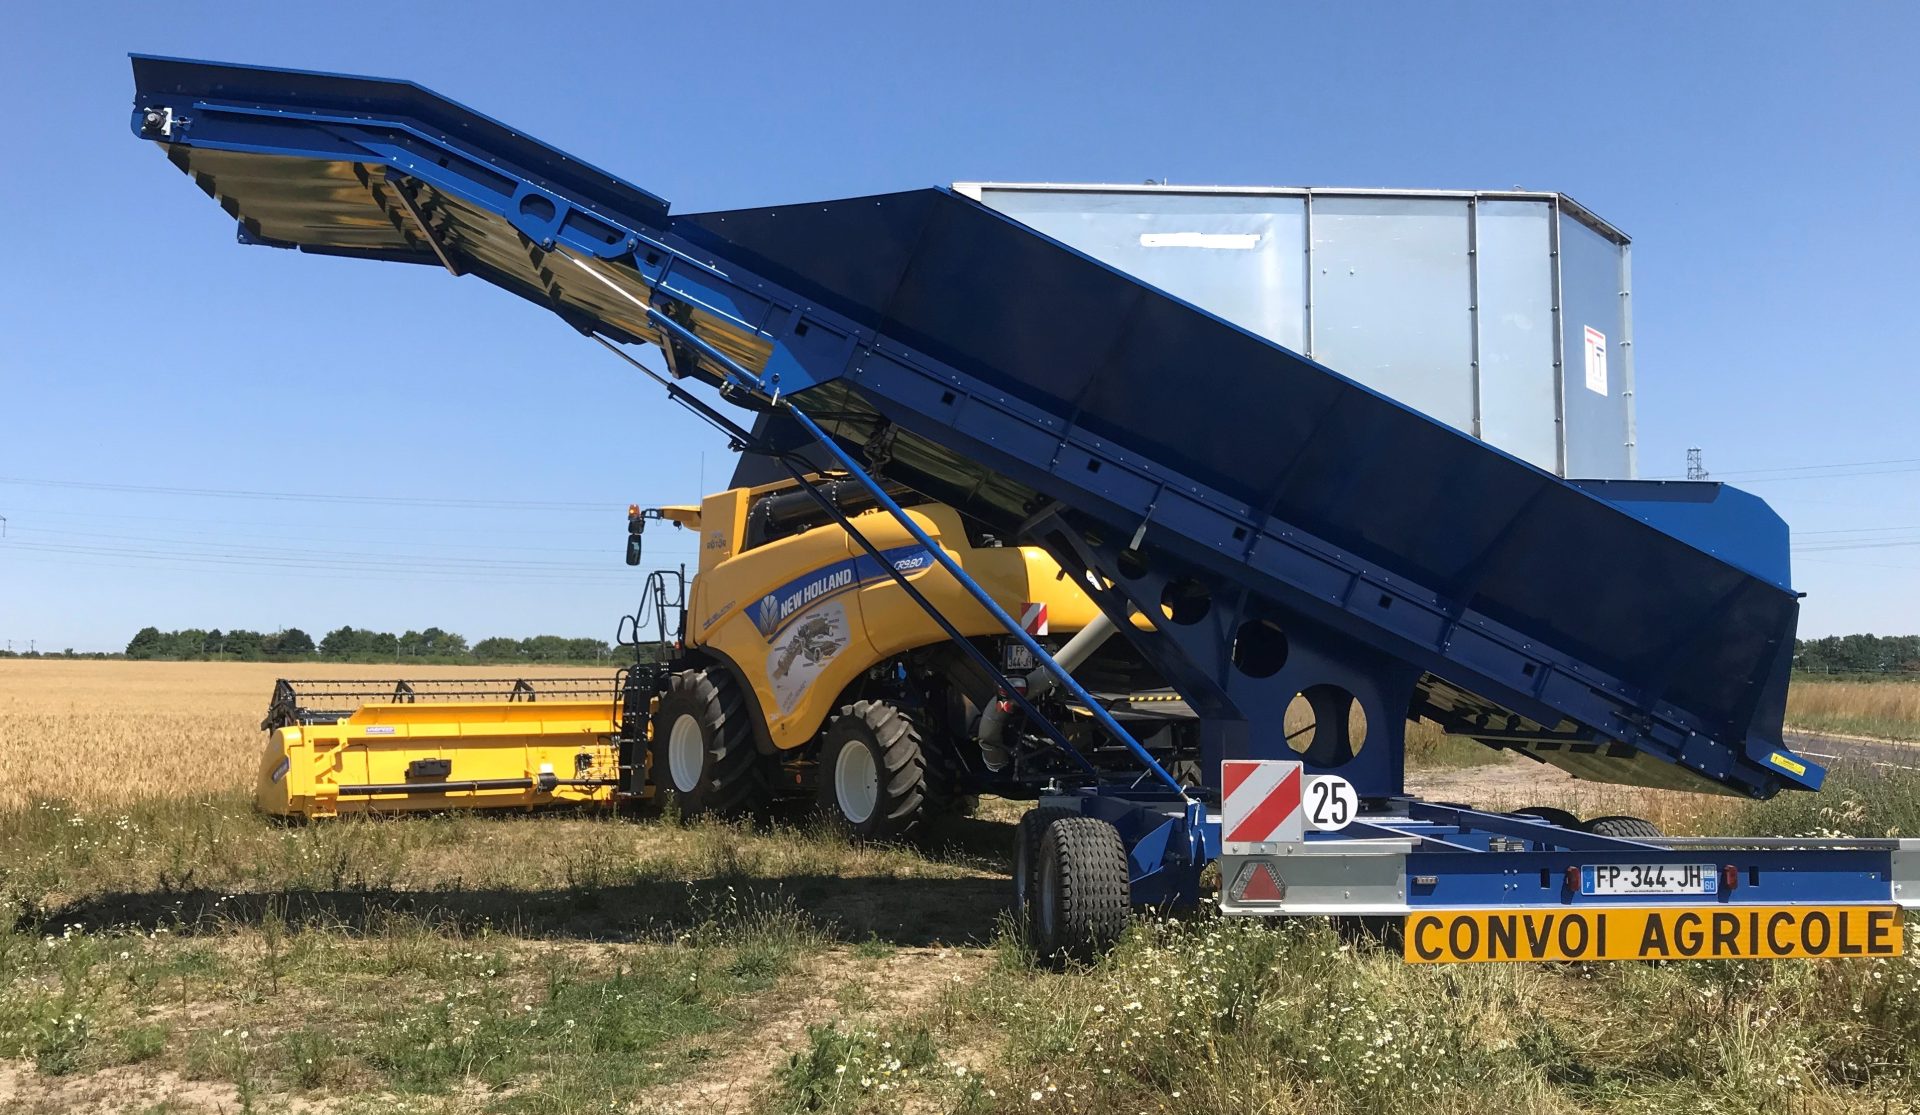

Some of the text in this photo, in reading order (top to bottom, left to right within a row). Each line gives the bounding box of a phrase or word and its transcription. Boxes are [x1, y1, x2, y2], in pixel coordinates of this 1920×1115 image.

[780, 568, 852, 619] NEW HOLLAND
[1312, 781, 1348, 825] 25
[1704, 880, 1715, 891] 60
[1414, 911, 1894, 961] CONVOI AGRICOLE
